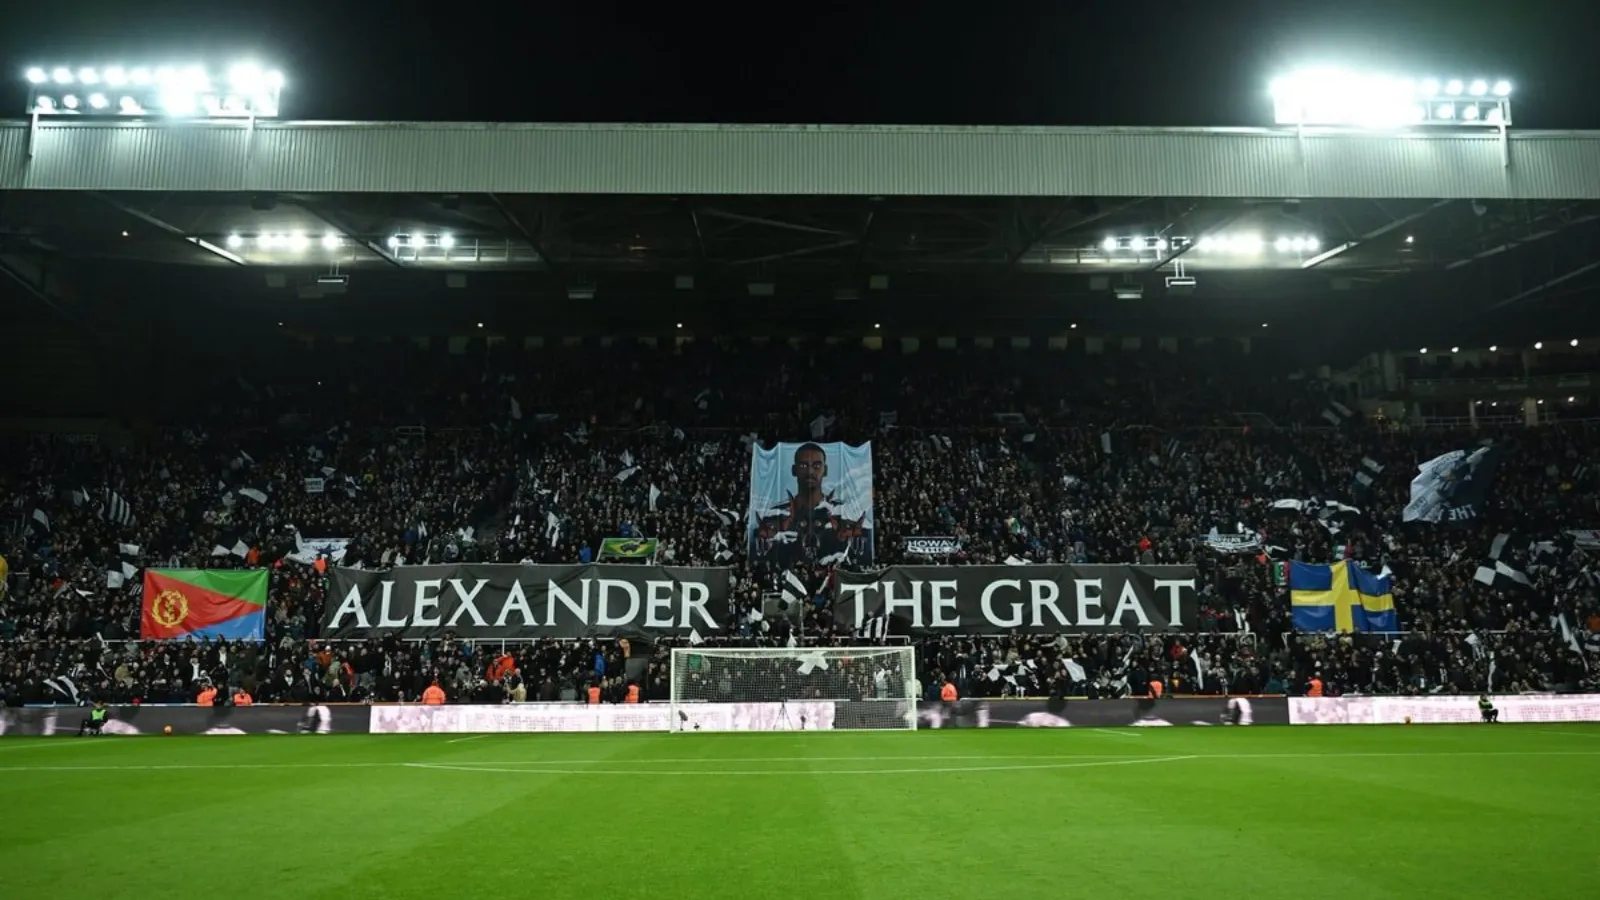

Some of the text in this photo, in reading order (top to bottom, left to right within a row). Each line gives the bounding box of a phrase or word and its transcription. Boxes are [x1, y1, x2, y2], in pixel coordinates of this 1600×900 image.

[327, 579, 720, 629] ALEXANDER
[840, 579, 1196, 628] THE GREAT
